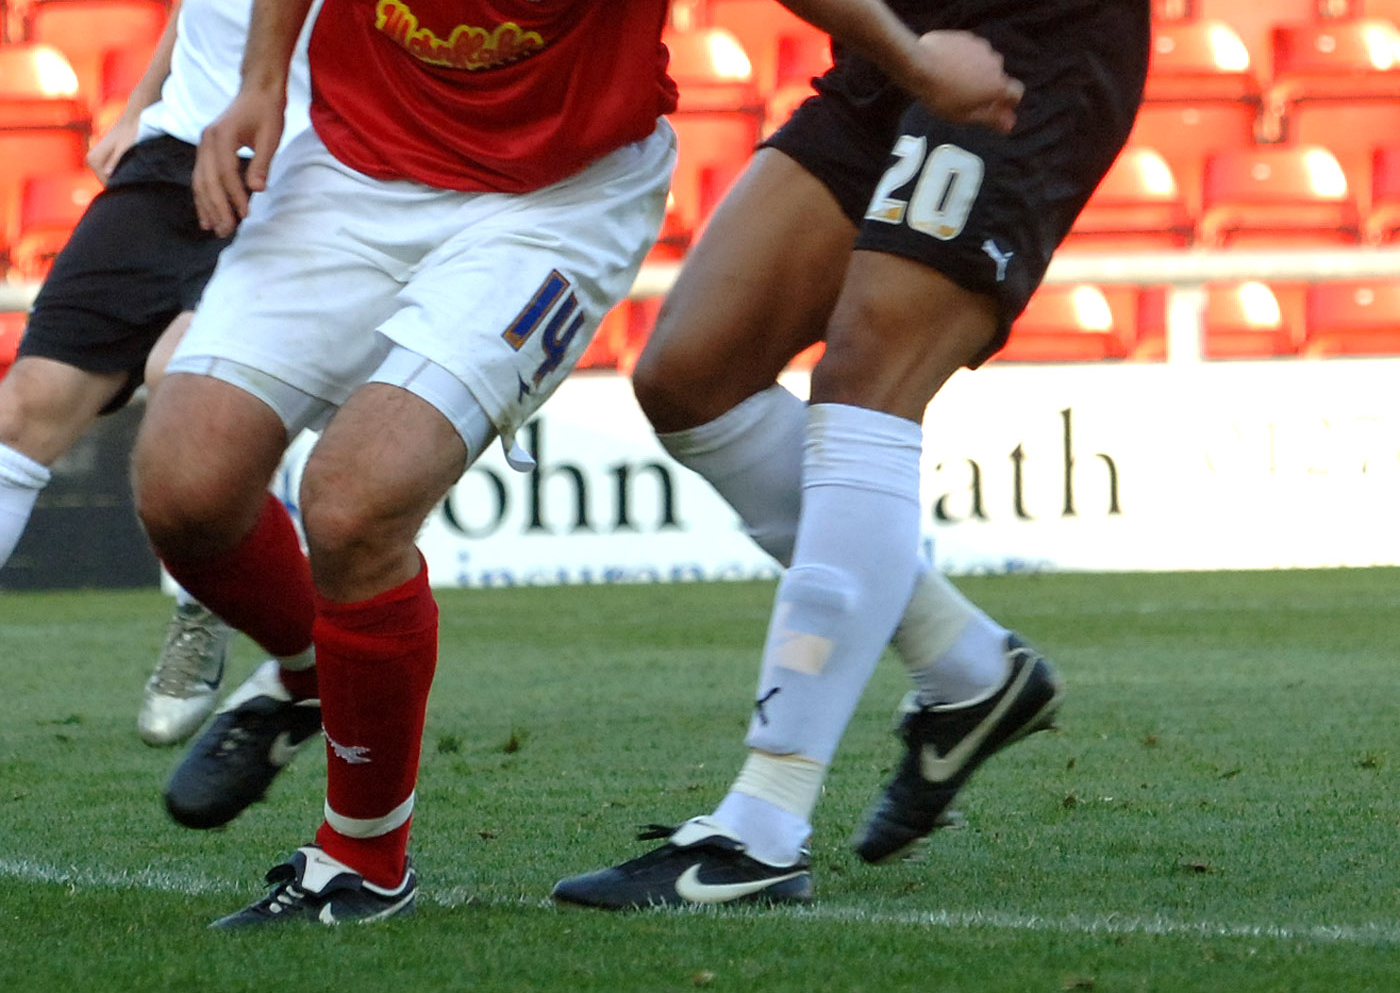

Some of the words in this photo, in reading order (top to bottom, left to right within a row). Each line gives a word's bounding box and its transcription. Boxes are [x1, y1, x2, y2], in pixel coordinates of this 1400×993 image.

[864, 135, 985, 240] 20
[501, 268, 585, 389] 14
[442, 417, 690, 539] ohn
[931, 407, 1124, 525] ath
